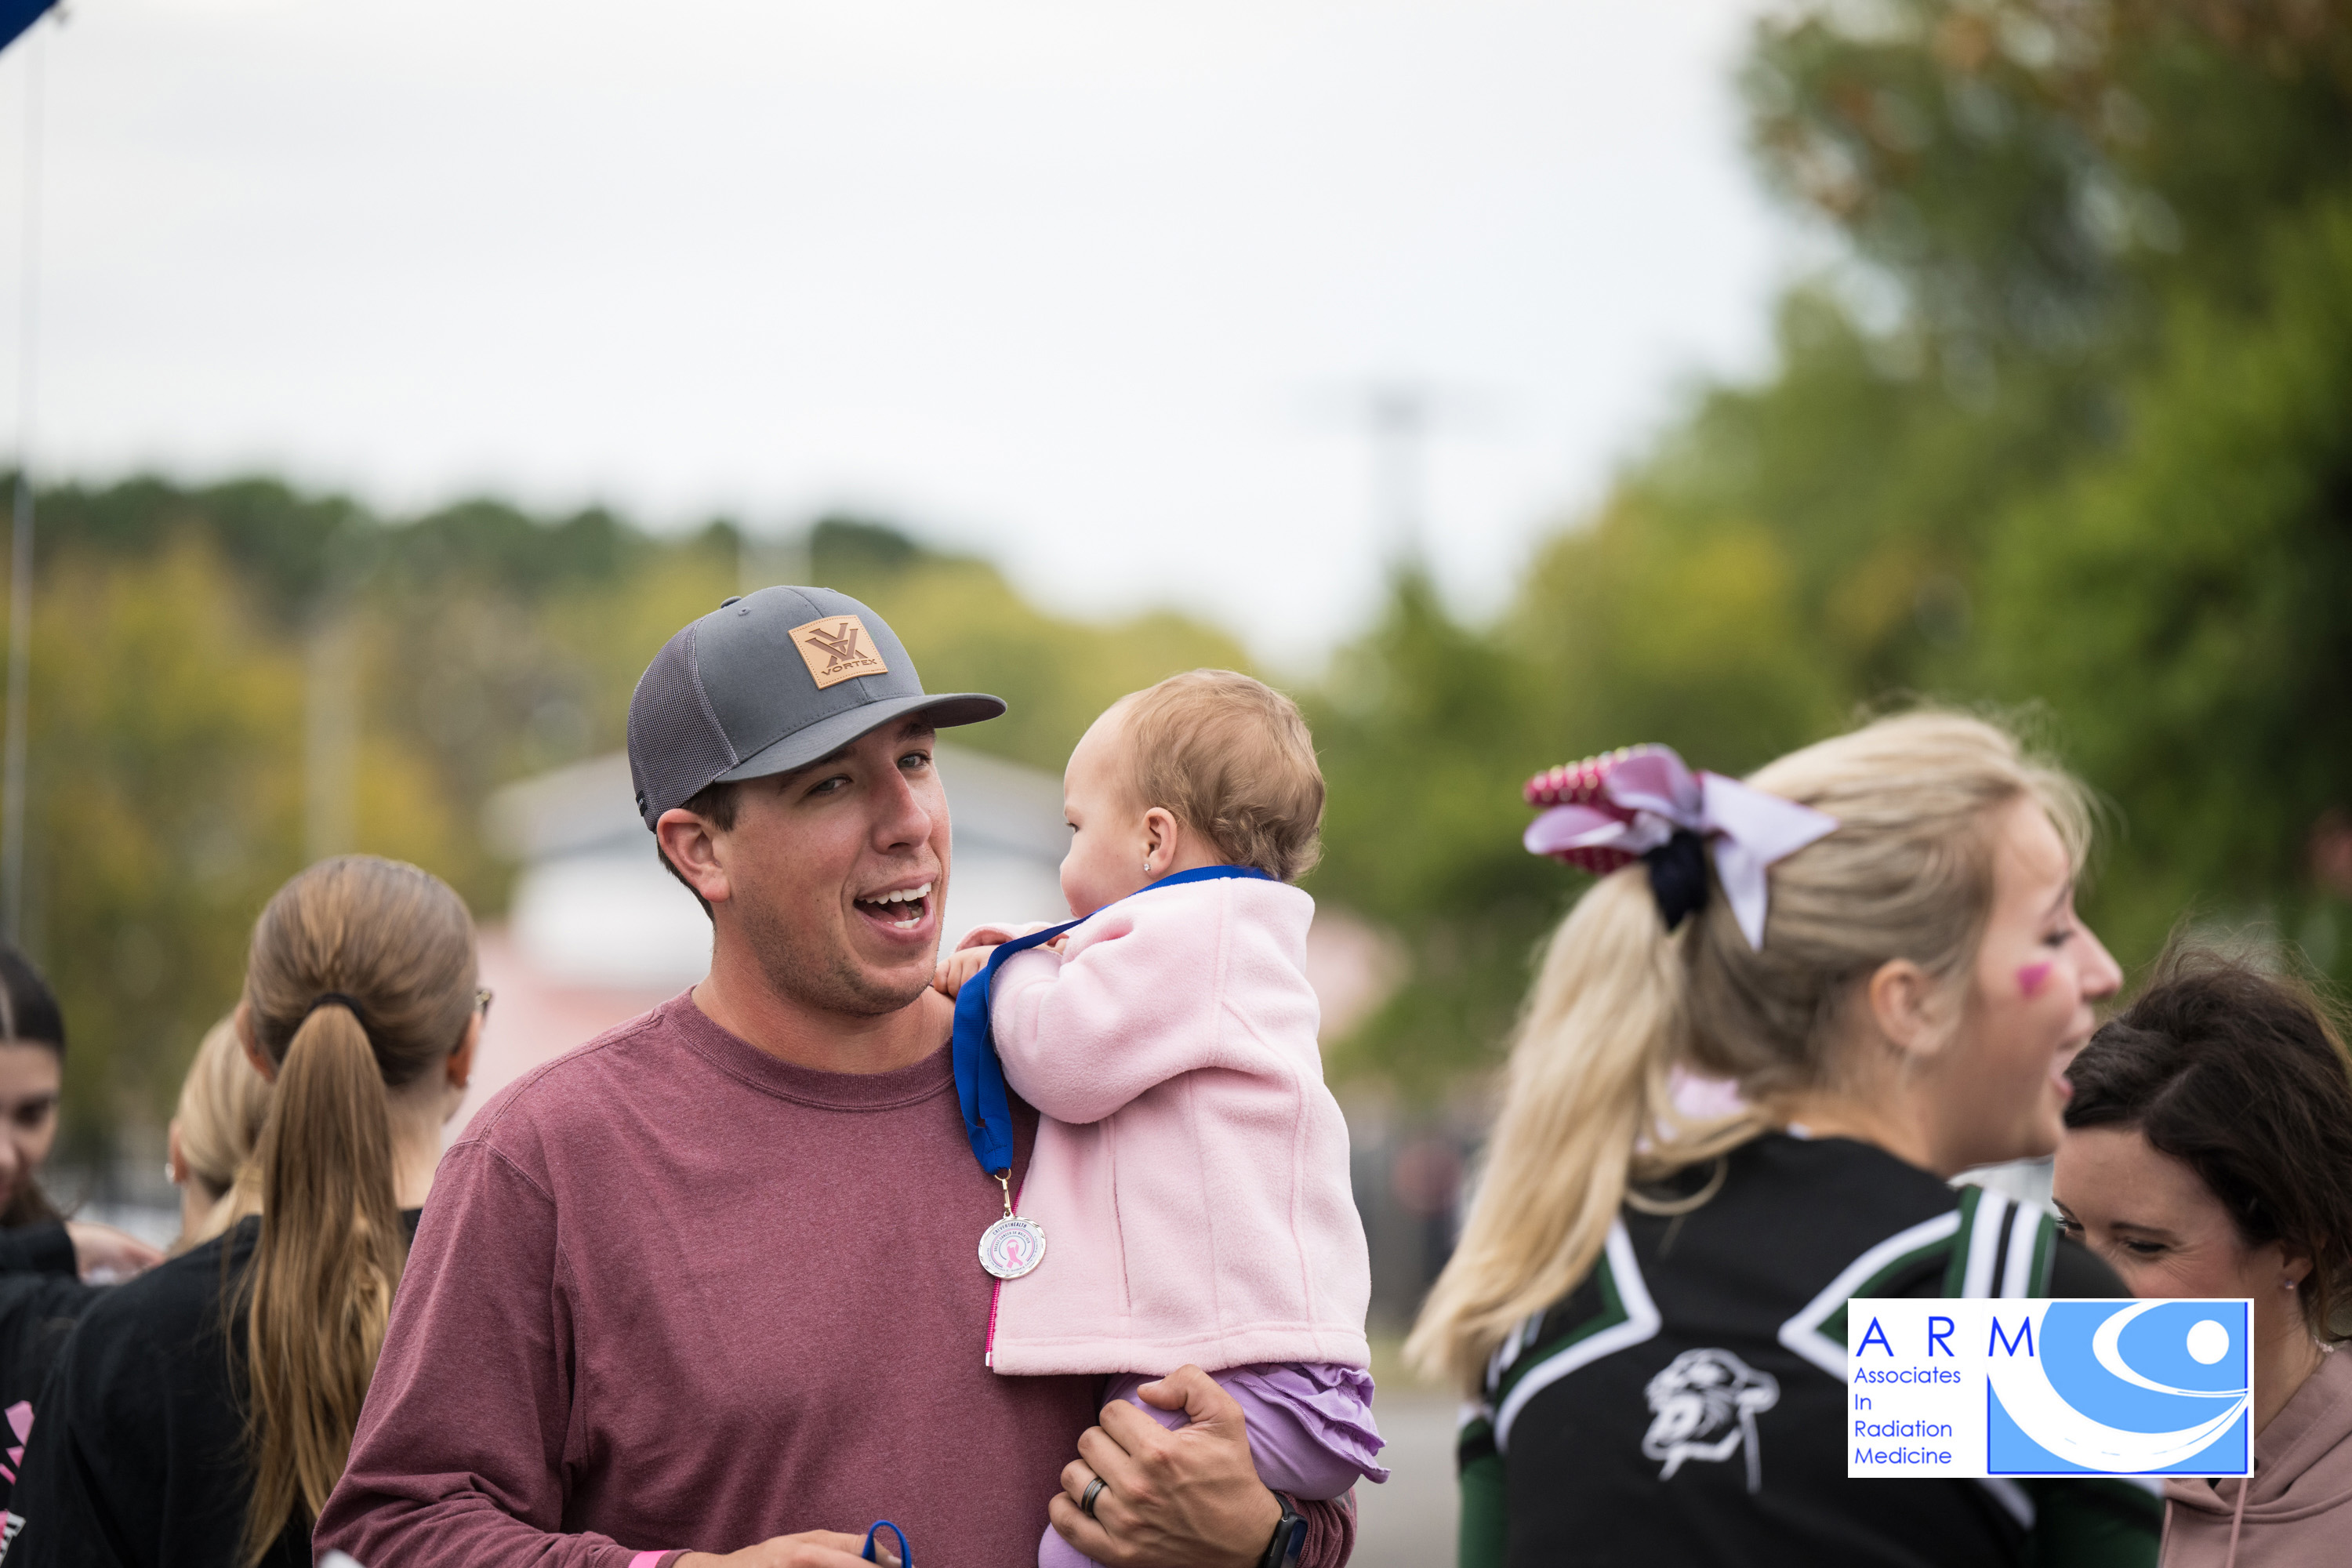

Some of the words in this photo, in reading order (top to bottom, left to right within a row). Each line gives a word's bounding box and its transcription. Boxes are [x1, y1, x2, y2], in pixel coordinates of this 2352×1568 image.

[821, 659, 877, 676] VORTEX
[993, 1222, 1027, 1236] CALVERTHEALTH
[1000, 1232, 1011, 1240] CANCER
